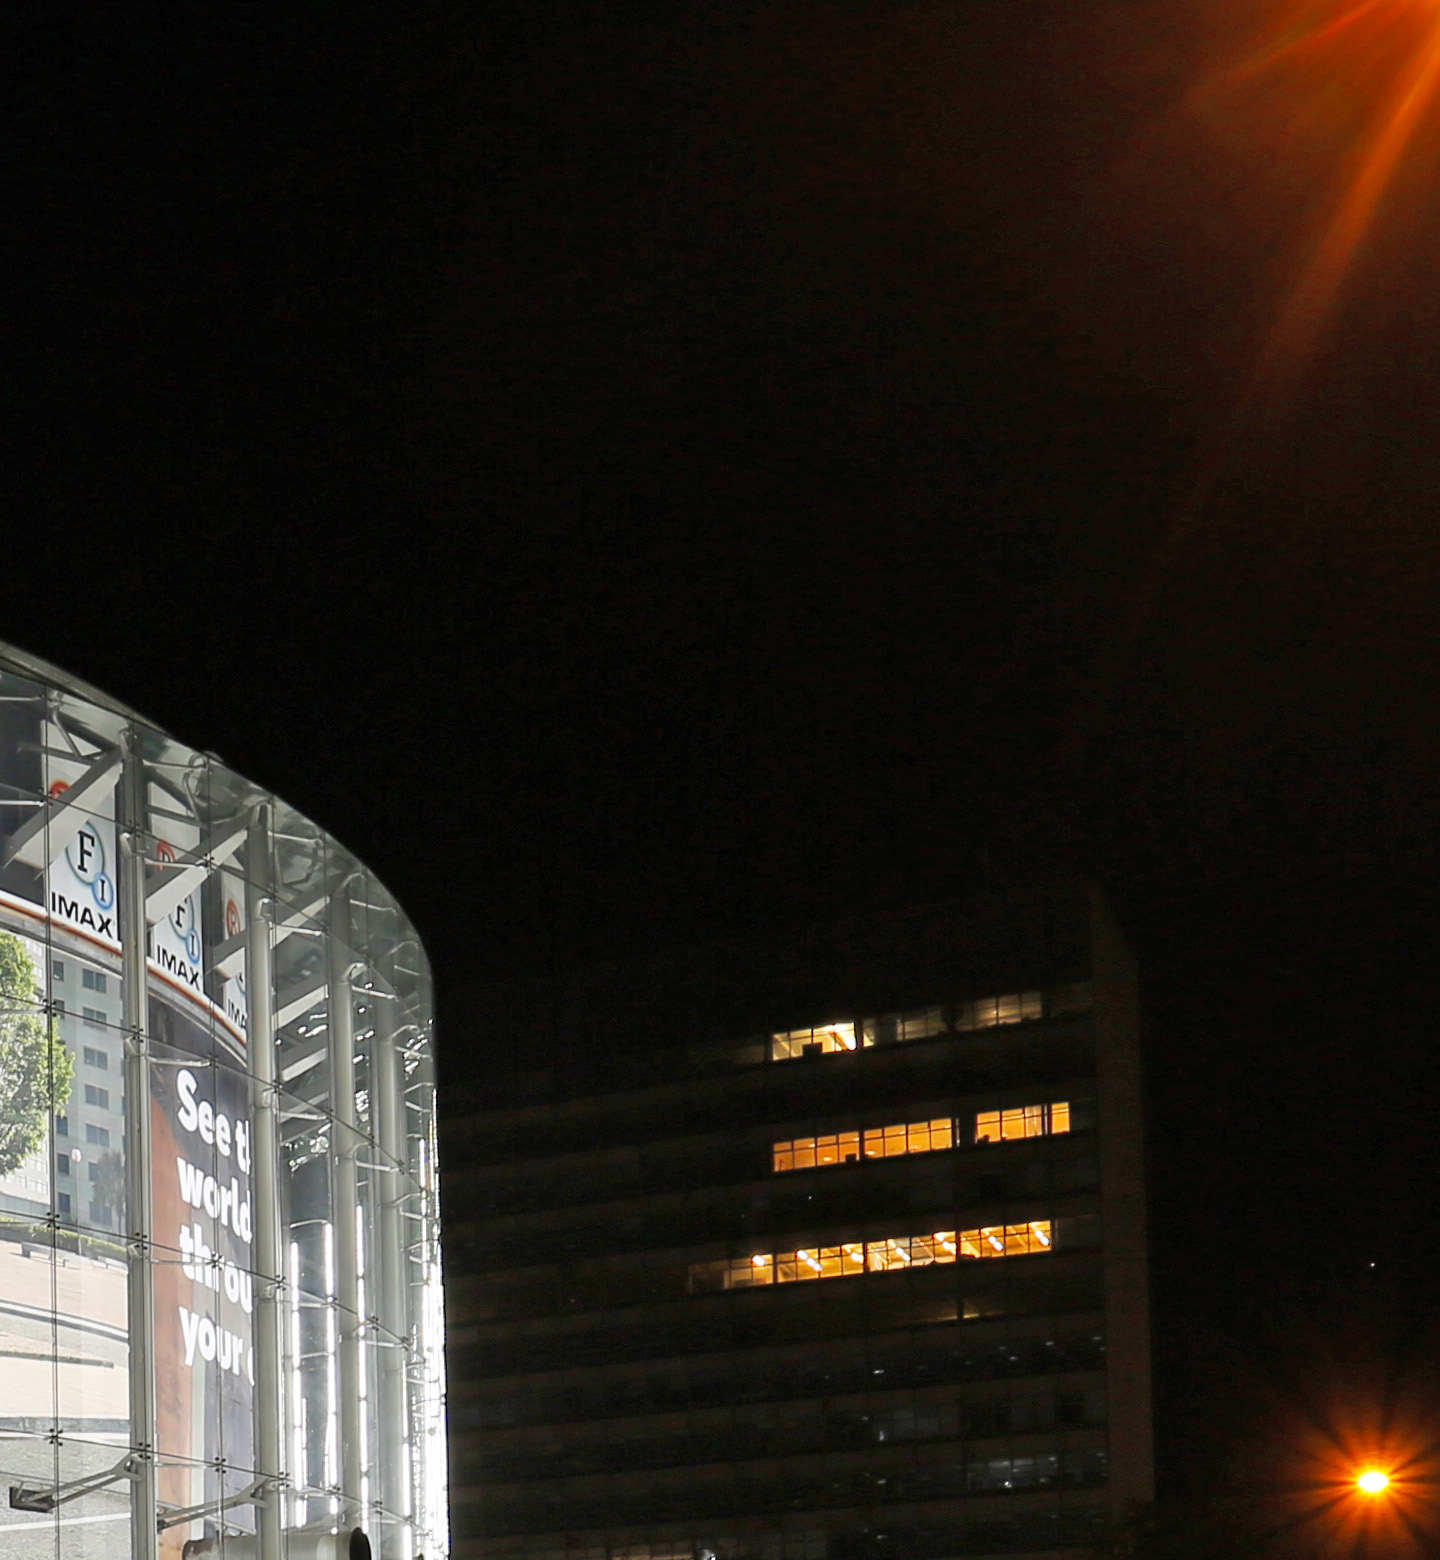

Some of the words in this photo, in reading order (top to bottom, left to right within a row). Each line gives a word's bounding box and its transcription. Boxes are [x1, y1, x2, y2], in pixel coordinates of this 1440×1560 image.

[51, 892, 113, 939] IMAX
[157, 944, 201, 992] IMAX
[177, 1069, 231, 1157] See
[176, 1156, 252, 1244] world
[178, 1306, 243, 1376] your
